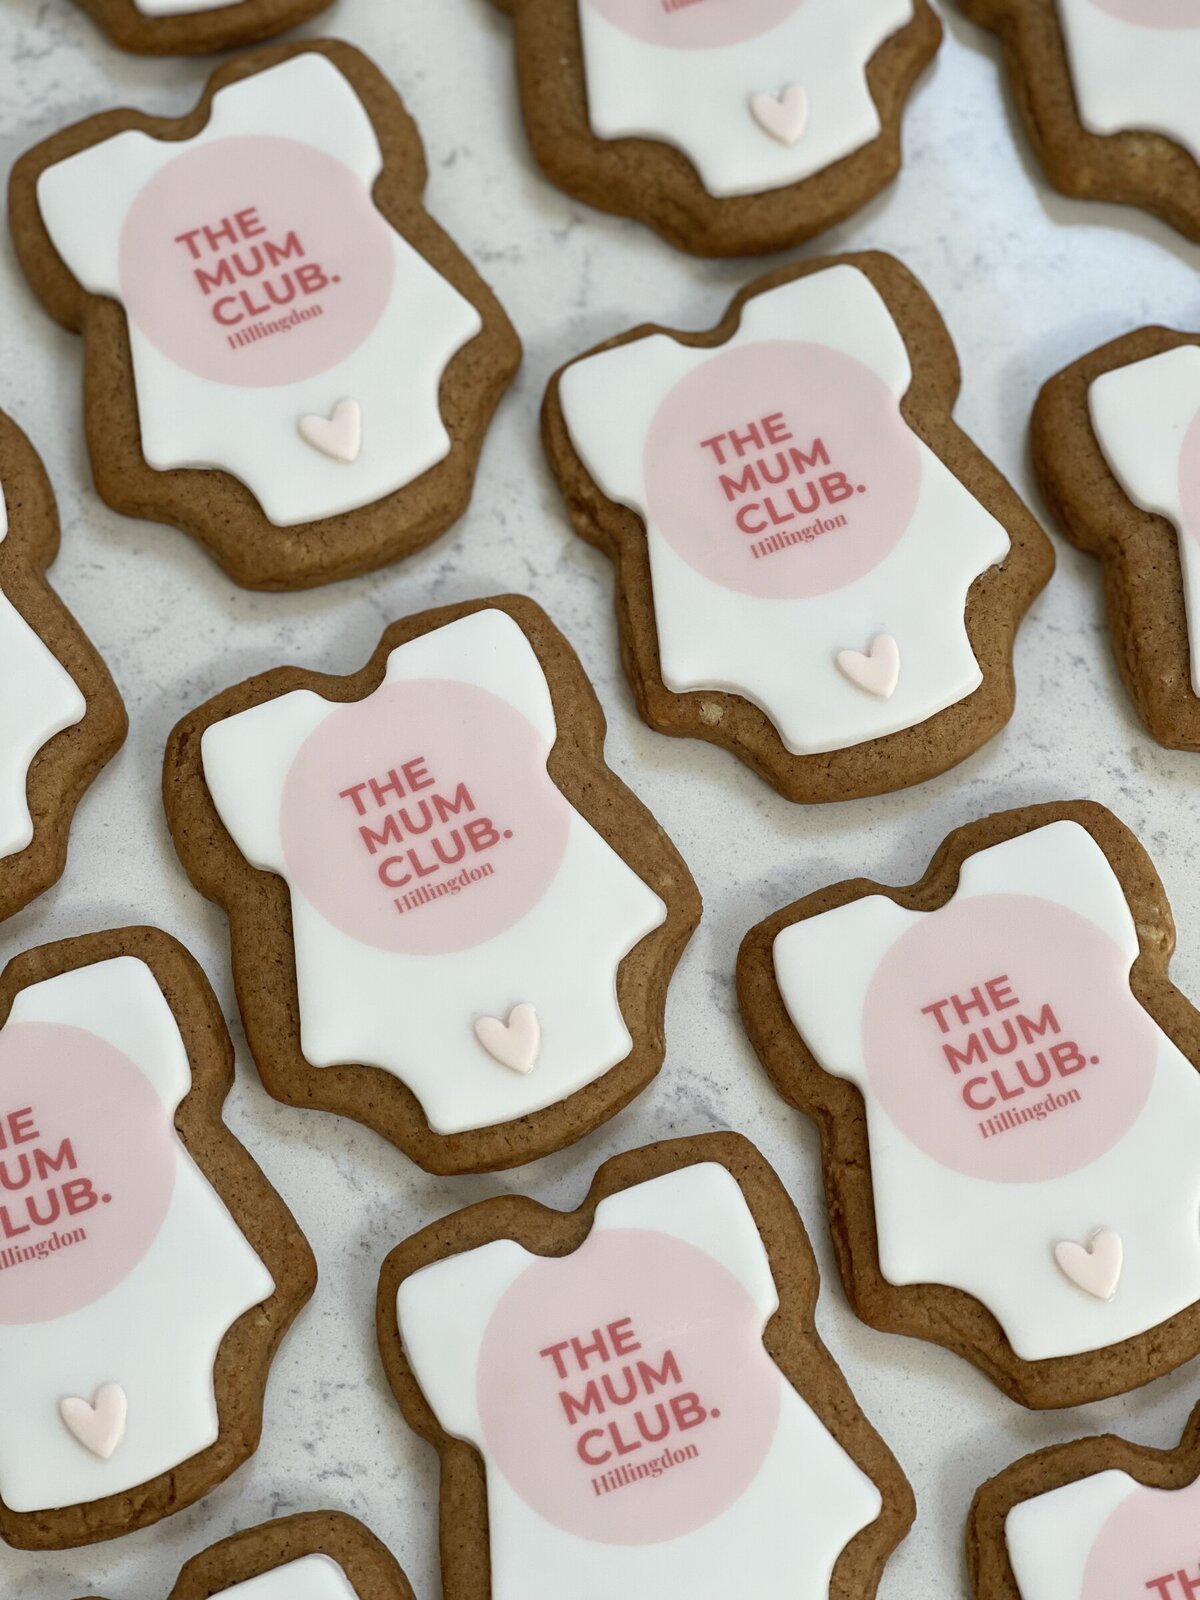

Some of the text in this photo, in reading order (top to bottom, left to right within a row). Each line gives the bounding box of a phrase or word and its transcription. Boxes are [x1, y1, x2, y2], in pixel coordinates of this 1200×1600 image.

[174, 206, 267, 260] THE
[193, 230, 305, 295] MUM
[211, 262, 341, 326] CLUB.
[226, 303, 324, 350] Hillingdon
[700, 411, 794, 465] THE
[718, 437, 831, 502] MUM
[735, 471, 866, 534] CLUB.
[750, 514, 848, 559] Hillingdon
[338, 756, 436, 816] THE
[358, 782, 476, 855] MUM
[377, 817, 513, 888] CLUB.
[393, 862, 495, 914] Hillingdon
[920, 974, 1020, 1034] THE
[941, 1003, 1062, 1075] MUM
[962, 1040, 1100, 1111] CLUB.
[978, 1088, 1082, 1139] Hillingdon
[0, 1227, 87, 1271] llingdon
[539, 1316, 642, 1379] THE
[558, 1349, 683, 1425] MUM
[576, 1391, 721, 1466] CLUB.
[591, 1444, 700, 1496] Hillingdon
